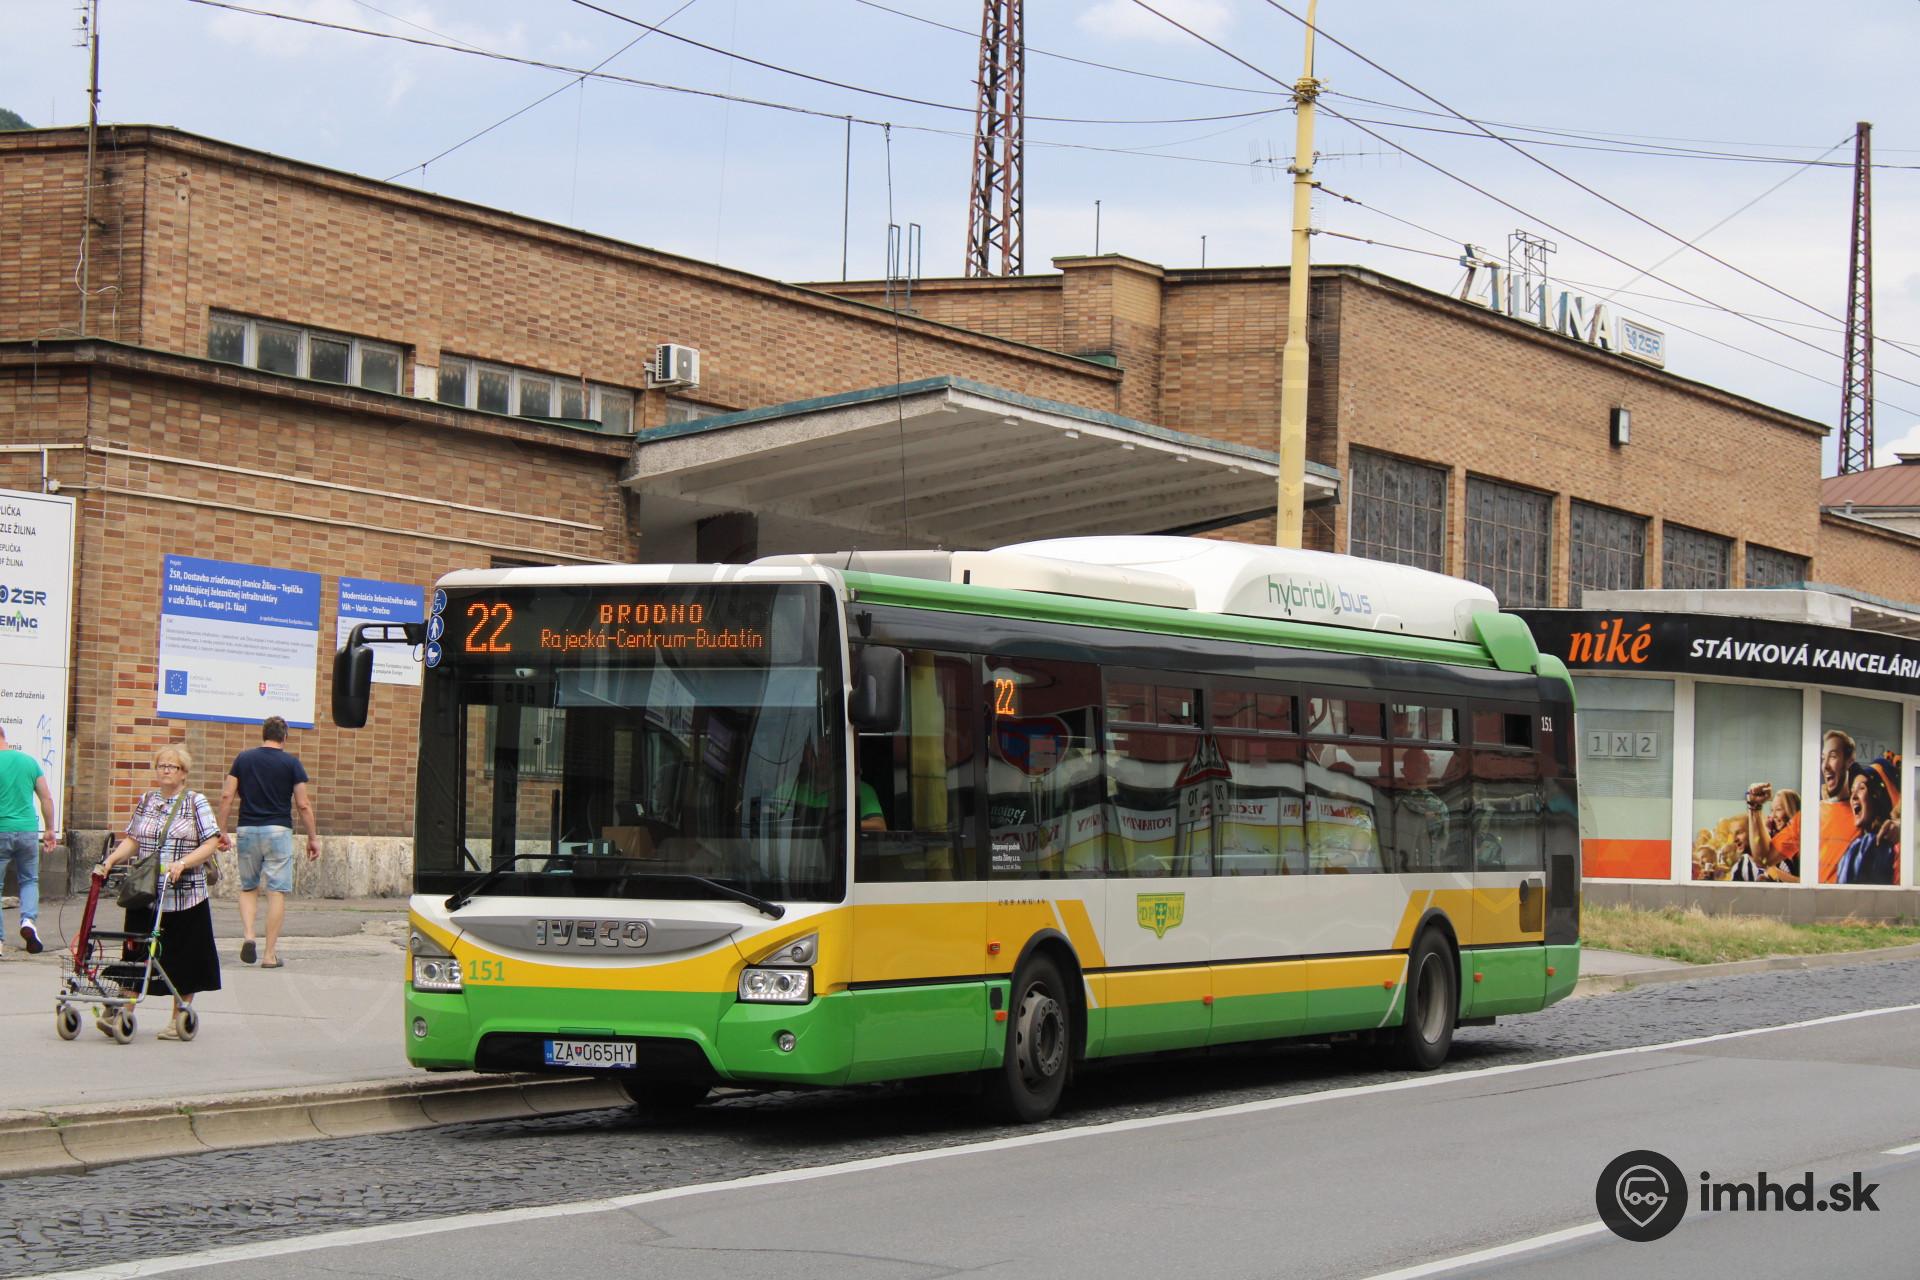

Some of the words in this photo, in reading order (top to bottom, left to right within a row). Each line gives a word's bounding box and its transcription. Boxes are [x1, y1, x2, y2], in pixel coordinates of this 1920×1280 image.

[13, 523, 36, 537] ŽILINA
[169, 567, 183, 581] ŽSR,
[183, 571, 209, 583] Dostavba
[261, 579, 277, 591] Žilina
[282, 583, 304, 595] Teplička
[11, 587, 47, 606] ŽSR
[1267, 574, 1327, 613] hybrid
[1337, 583, 1373, 615] bus
[599, 604, 704, 624] BRODNO
[465, 603, 513, 652] 22
[541, 627, 763, 652] Rajecká-Centrum-Budatín
[1568, 617, 1652, 664] niké
[1689, 636, 1810, 667] STÁVKOVÁ
[14, 690, 45, 700] združenia
[995, 677, 1015, 715] 22
[1541, 716, 1553, 732] 151
[1616, 736, 1629, 753] X
[1640, 736, 1652, 753] 2
[536, 919, 648, 948] IVECO
[468, 959, 505, 981] 151
